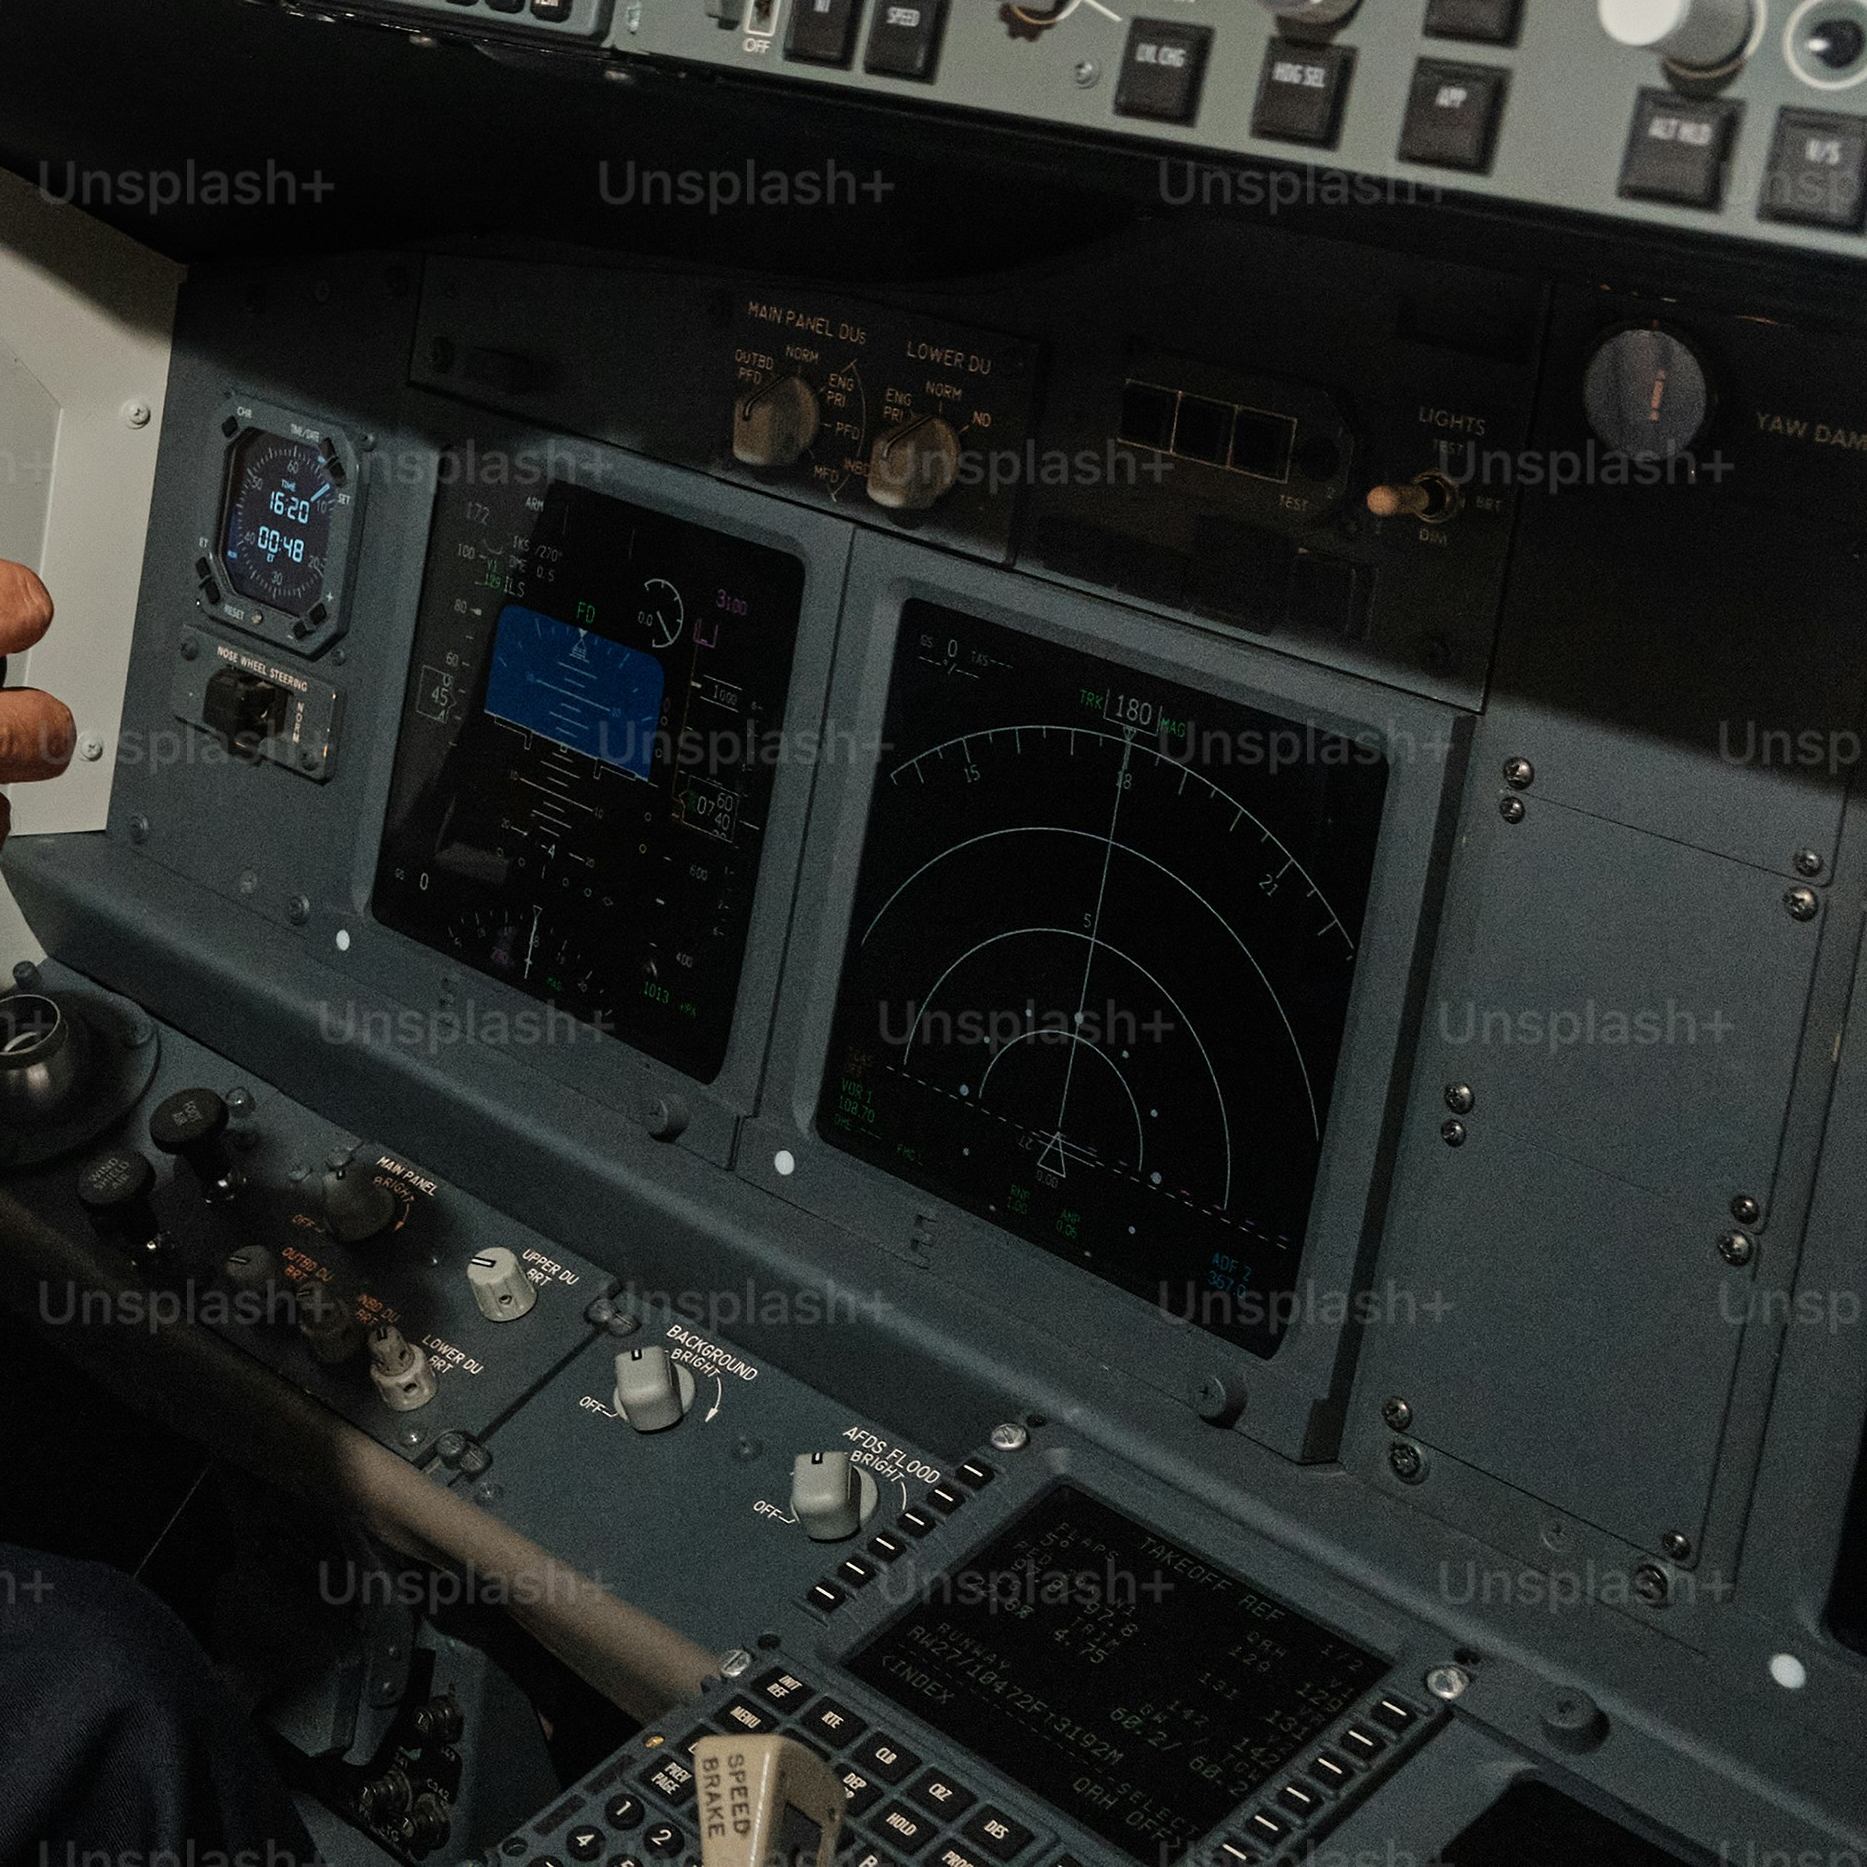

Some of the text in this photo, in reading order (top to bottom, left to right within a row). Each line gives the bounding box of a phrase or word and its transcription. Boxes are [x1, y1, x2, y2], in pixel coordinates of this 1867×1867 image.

[742, 37, 771, 53] OFF
[748, 300, 783, 325] MAIN
[785, 311, 835, 339] PANEL
[734, 348, 775, 371] OUTBD
[785, 344, 820, 365] NORM
[907, 340, 993, 376] LOWER DU
[737, 366, 763, 386] PFD
[828, 372, 855, 393] ENG
[826, 389, 848, 408] PRI
[885, 386, 914, 407] ENG
[925, 379, 964, 402] NORM
[883, 404, 906, 424] PRI
[973, 410, 992, 428] ND
[1418, 405, 1487, 437] LIGHTS
[1755, 410, 1809, 439] YAW
[835, 421, 861, 441] PFD
[287, 459, 300, 476] 60
[813, 464, 841, 484] MFD
[269, 491, 311, 525] 16:20
[337, 491, 352, 505] SET
[525, 495, 546, 513] ARM
[256, 525, 306, 564] 00:48
[222, 603, 247, 622] RESET
[575, 599, 597, 625] FD
[217, 645, 309, 693] NOSE WHEEL STEERING
[1078, 688, 1188, 739] TRK 180 MAG
[841, 1077, 864, 1101] VOR
[376, 1155, 438, 1197] MAIN PANEL
[282, 1246, 333, 1283] OUTBD DU
[521, 1248, 581, 1287] UPPER DU
[1211, 1252, 1239, 1274] ADF
[421, 1333, 485, 1376] LOWER DU
[666, 1323, 759, 1382] BACKGROUND
[670, 1347, 723, 1379] BRIGHT
[578, 1395, 608, 1414] OFF
[842, 1426, 942, 1485] AFDS FLOOD
[849, 1449, 907, 1483] BRIGHT
[752, 1499, 784, 1520] OFF
[1140, 1536, 1233, 1593] TAKEOFF
[1238, 1593, 1287, 1623] REF
[730, 1705, 763, 1729] MENU
[874, 1746, 898, 1765] CLB
[650, 1771, 681, 1796] PAGE
[665, 1761, 693, 1784] PREV
[842, 1771, 868, 1790] DEP
[702, 1759, 726, 1839] BRAKE
[727, 1752, 752, 1838] SPEED
[928, 1782, 954, 1803] CRZ
[616, 1800, 632, 1816] 1
[885, 1811, 918, 1837] HOLD
[983, 1819, 1010, 1840] DES
[575, 1833, 596, 1848] 4
[650, 1828, 673, 1846] 2
